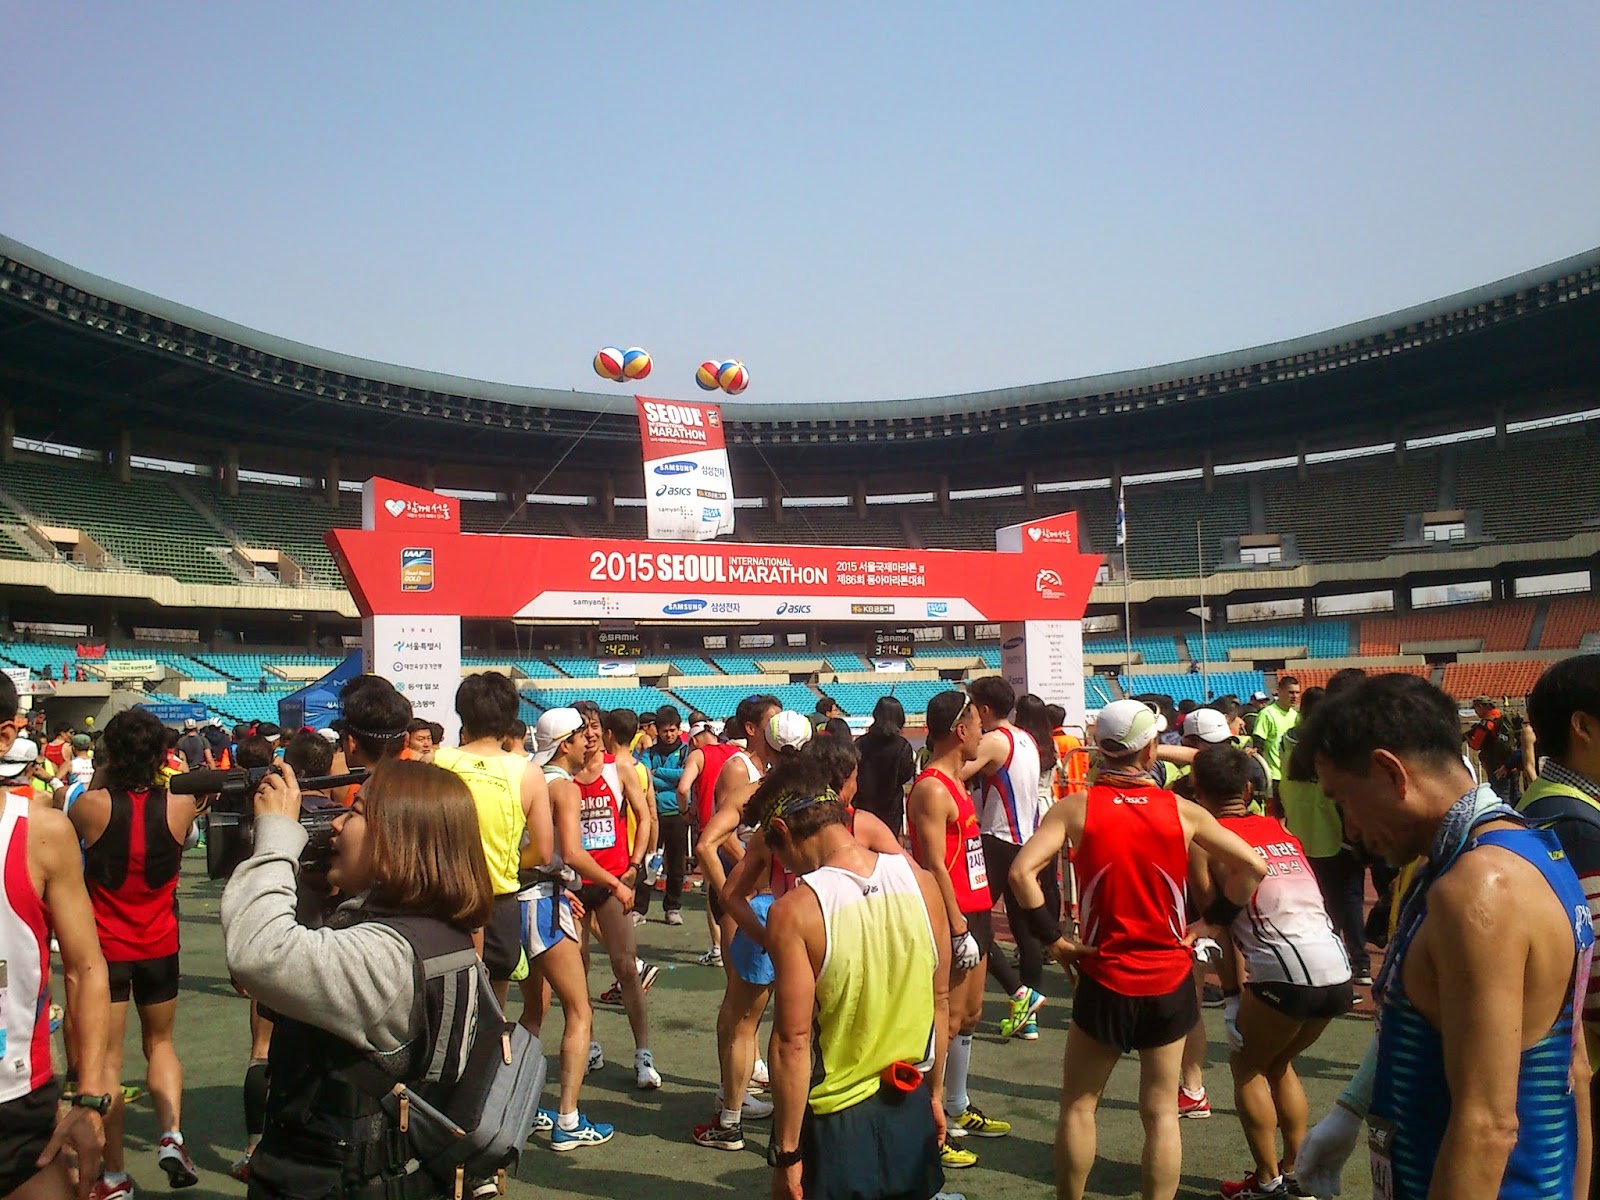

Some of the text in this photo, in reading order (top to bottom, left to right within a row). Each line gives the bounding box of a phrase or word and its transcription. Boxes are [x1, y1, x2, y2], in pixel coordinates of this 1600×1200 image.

[643, 402, 704, 427] SEOUL
[648, 426, 707, 441] MARATHON
[667, 487, 691, 496] asics
[589, 550, 727, 583] 2015 SEOUL
[728, 556, 793, 567] INTERNATIONAL
[836, 561, 857, 572] 2015
[859, 561, 917, 574] 서울국제마라톤
[728, 565, 829, 585] MARATHON
[573, 598, 606, 607] samyang
[668, 602, 702, 611] SAMSUNG
[710, 602, 740, 613] 삼성전자
[787, 604, 812, 614] asics
[608, 633, 640, 642] SAMIK
[583, 820, 613, 835] 5013
[1265, 841, 1300, 858] 마라톤
